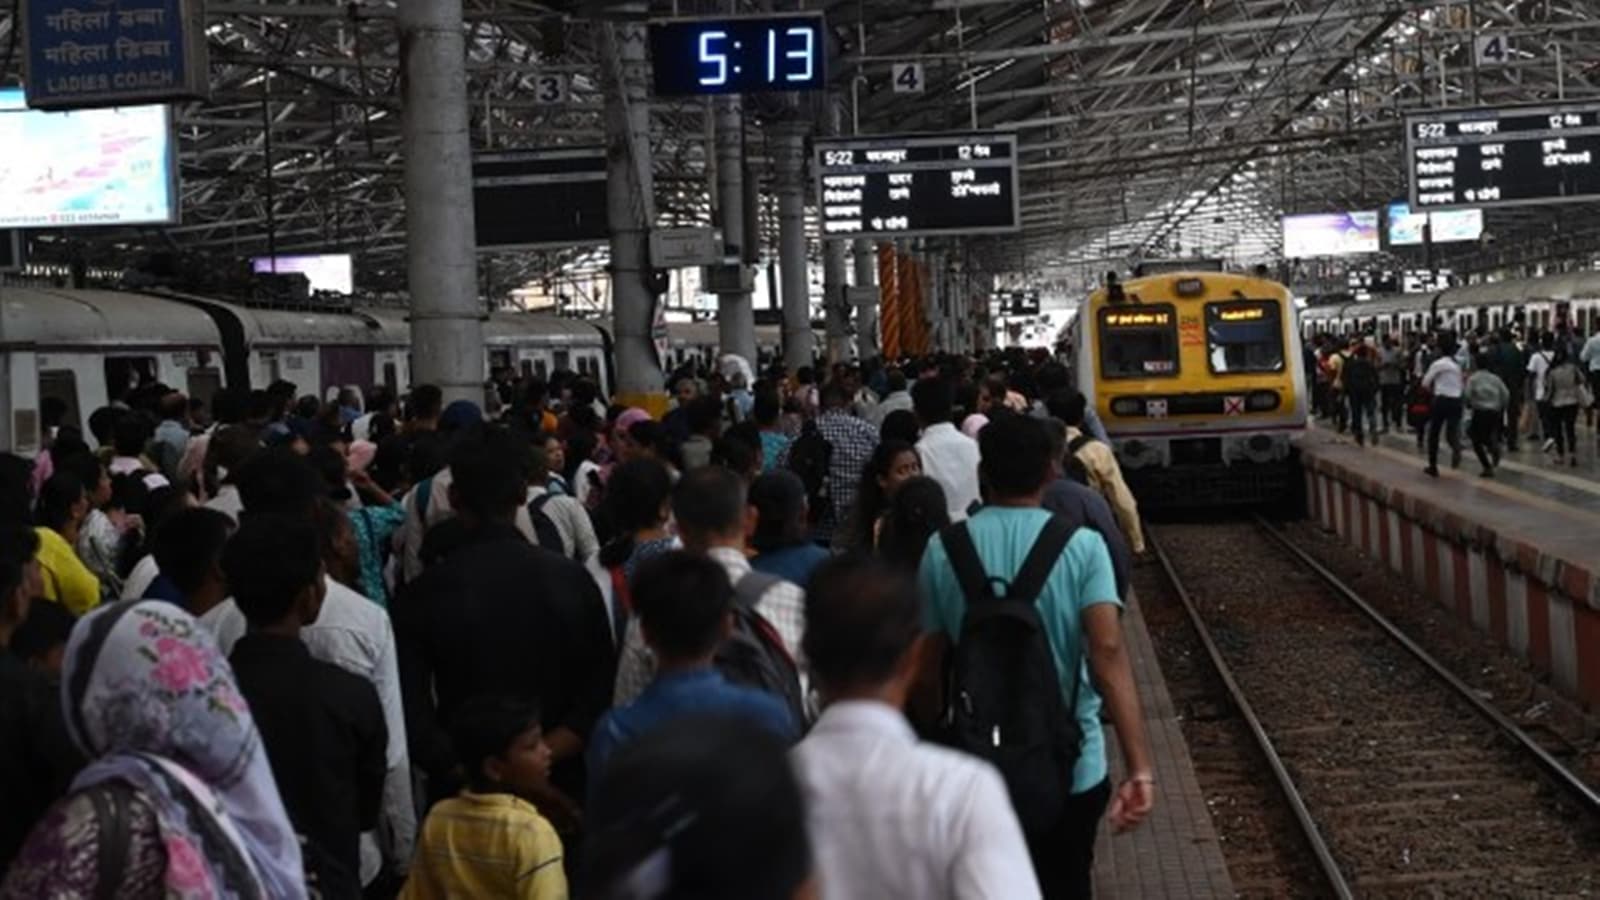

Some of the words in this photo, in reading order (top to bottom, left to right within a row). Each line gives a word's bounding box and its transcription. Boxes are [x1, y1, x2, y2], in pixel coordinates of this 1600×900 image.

[45, 8, 110, 33] महिला
[43, 41, 109, 66] महिला
[115, 37, 172, 61] डिब्बा
[698, 28, 813, 85] 5:13
[1484, 37, 1504, 60] 4
[47, 73, 109, 93] LADIES
[114, 70, 173, 88] COACH
[539, 77, 560, 101] 3
[897, 65, 918, 89] 4
